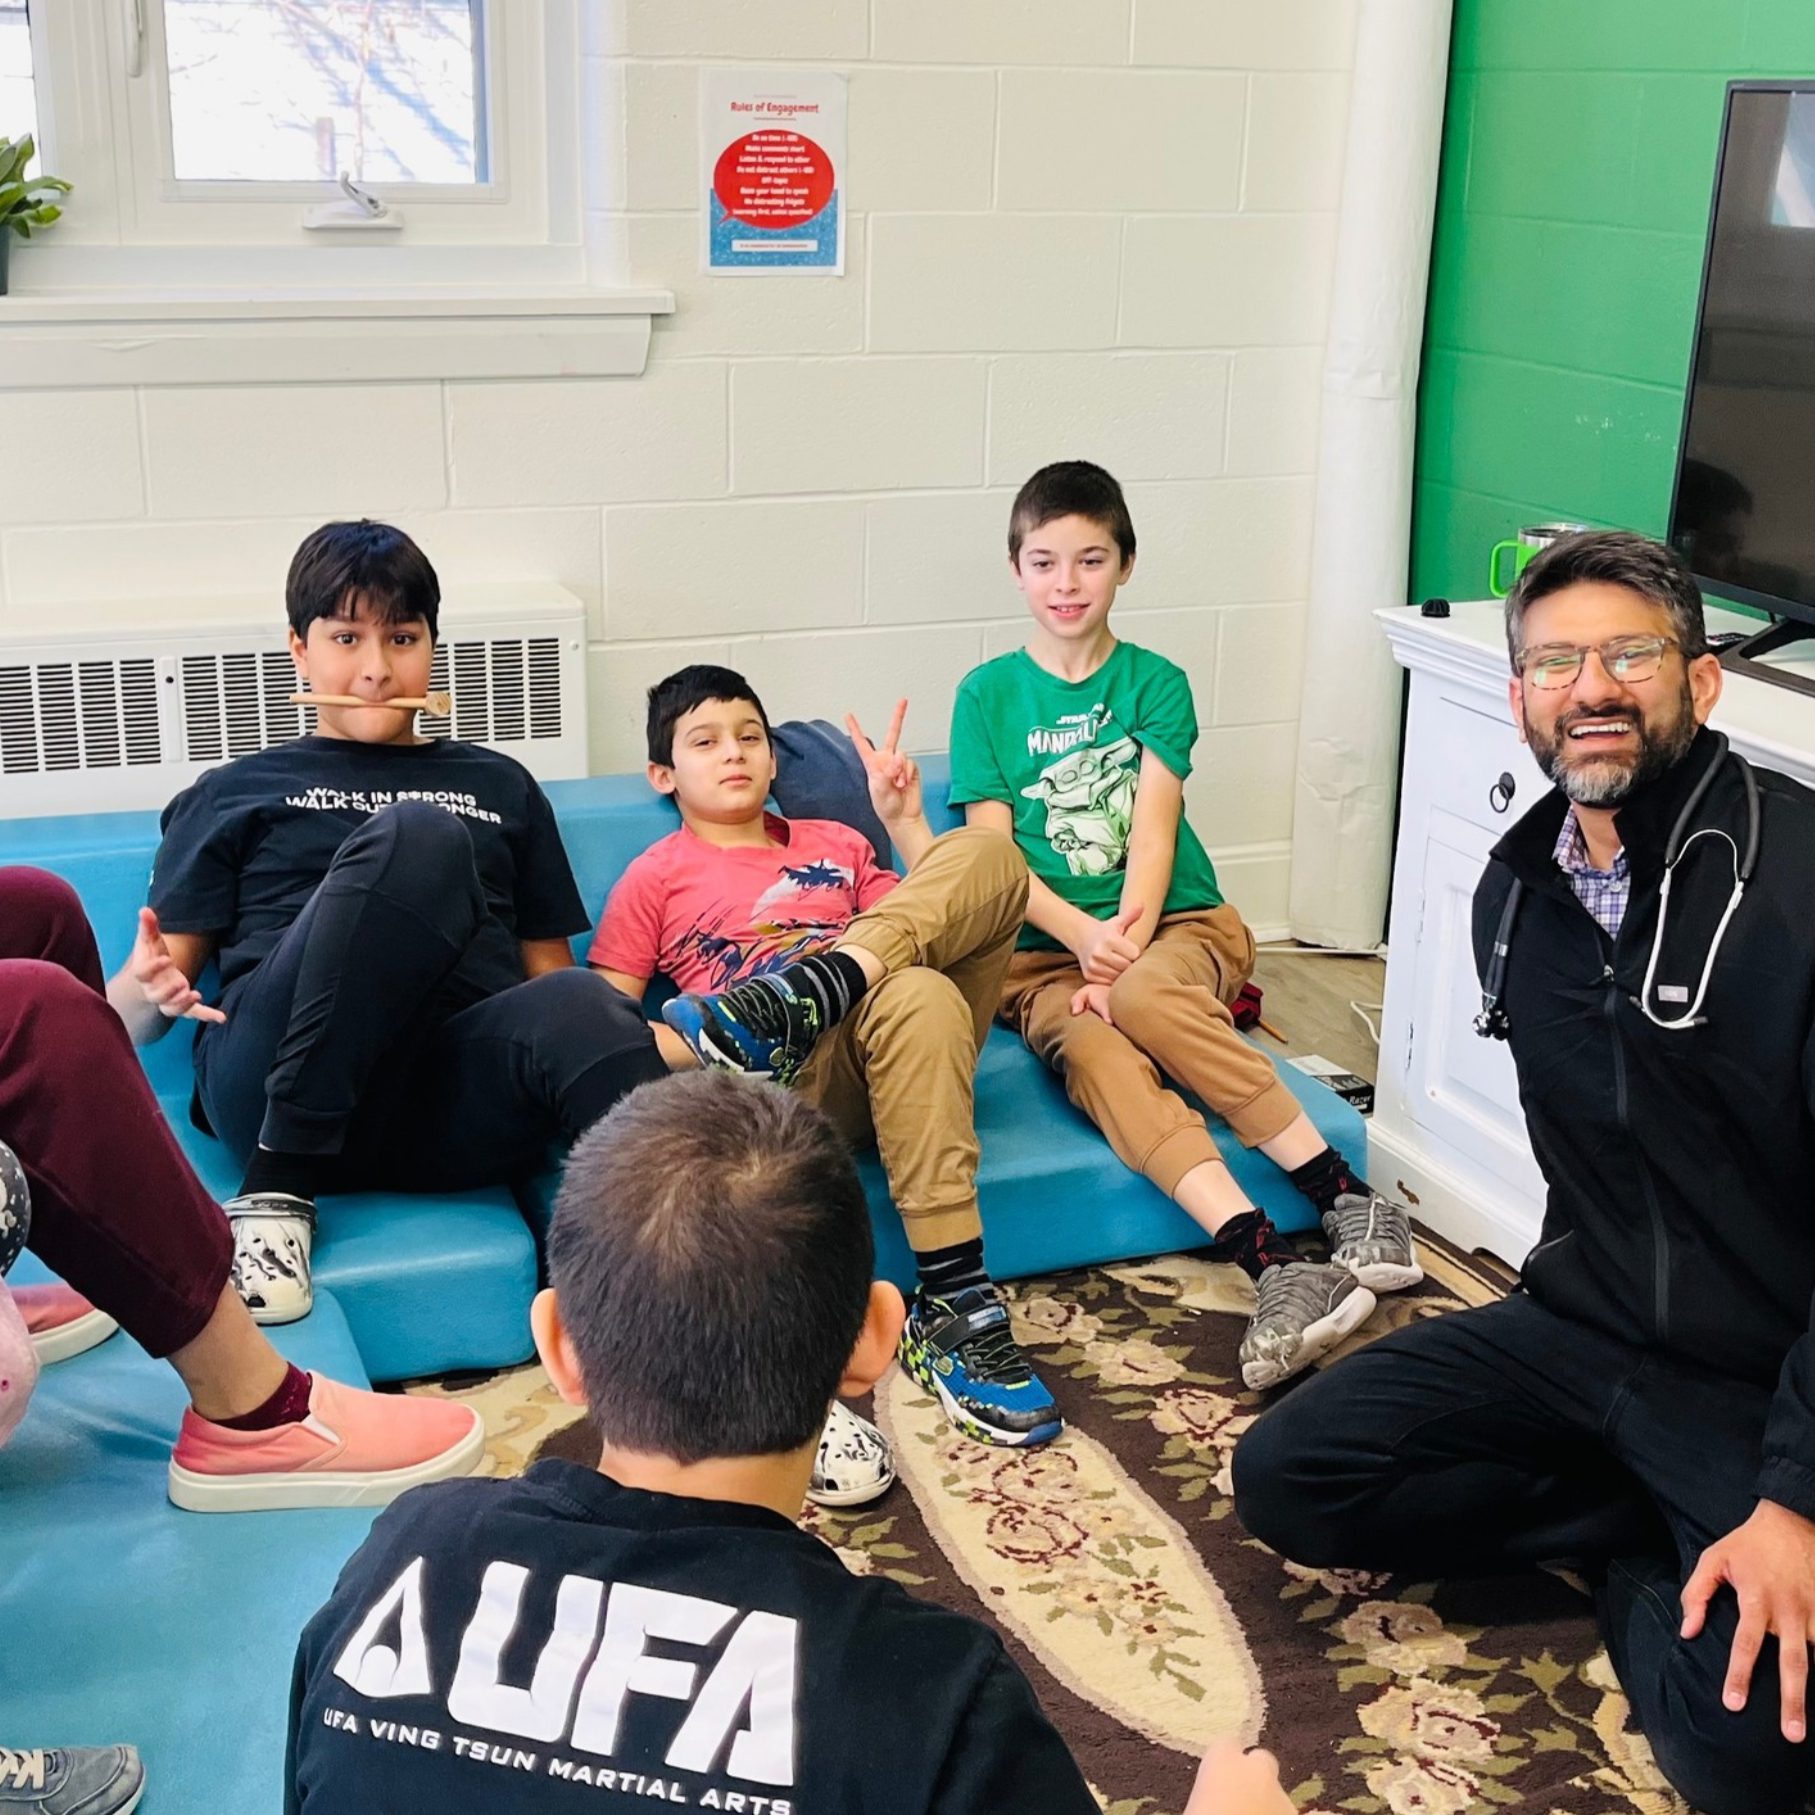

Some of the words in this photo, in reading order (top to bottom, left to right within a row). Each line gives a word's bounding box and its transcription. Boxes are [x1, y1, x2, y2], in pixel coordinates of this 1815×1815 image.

[731, 101, 753, 112] Rules
[755, 101, 765, 112] of
[767, 102, 819, 116] Engagement
[285, 796, 348, 810] WALK
[306, 787, 366, 802] WALK
[370, 791, 392, 803] IN
[447, 1560, 799, 1787] UFA
[323, 1707, 357, 1734] UFA
[370, 1718, 441, 1750] VING
[453, 1736, 537, 1771] TSUN
[548, 1757, 687, 1803] MARTIAL
[699, 1788, 792, 1815] ARTS
